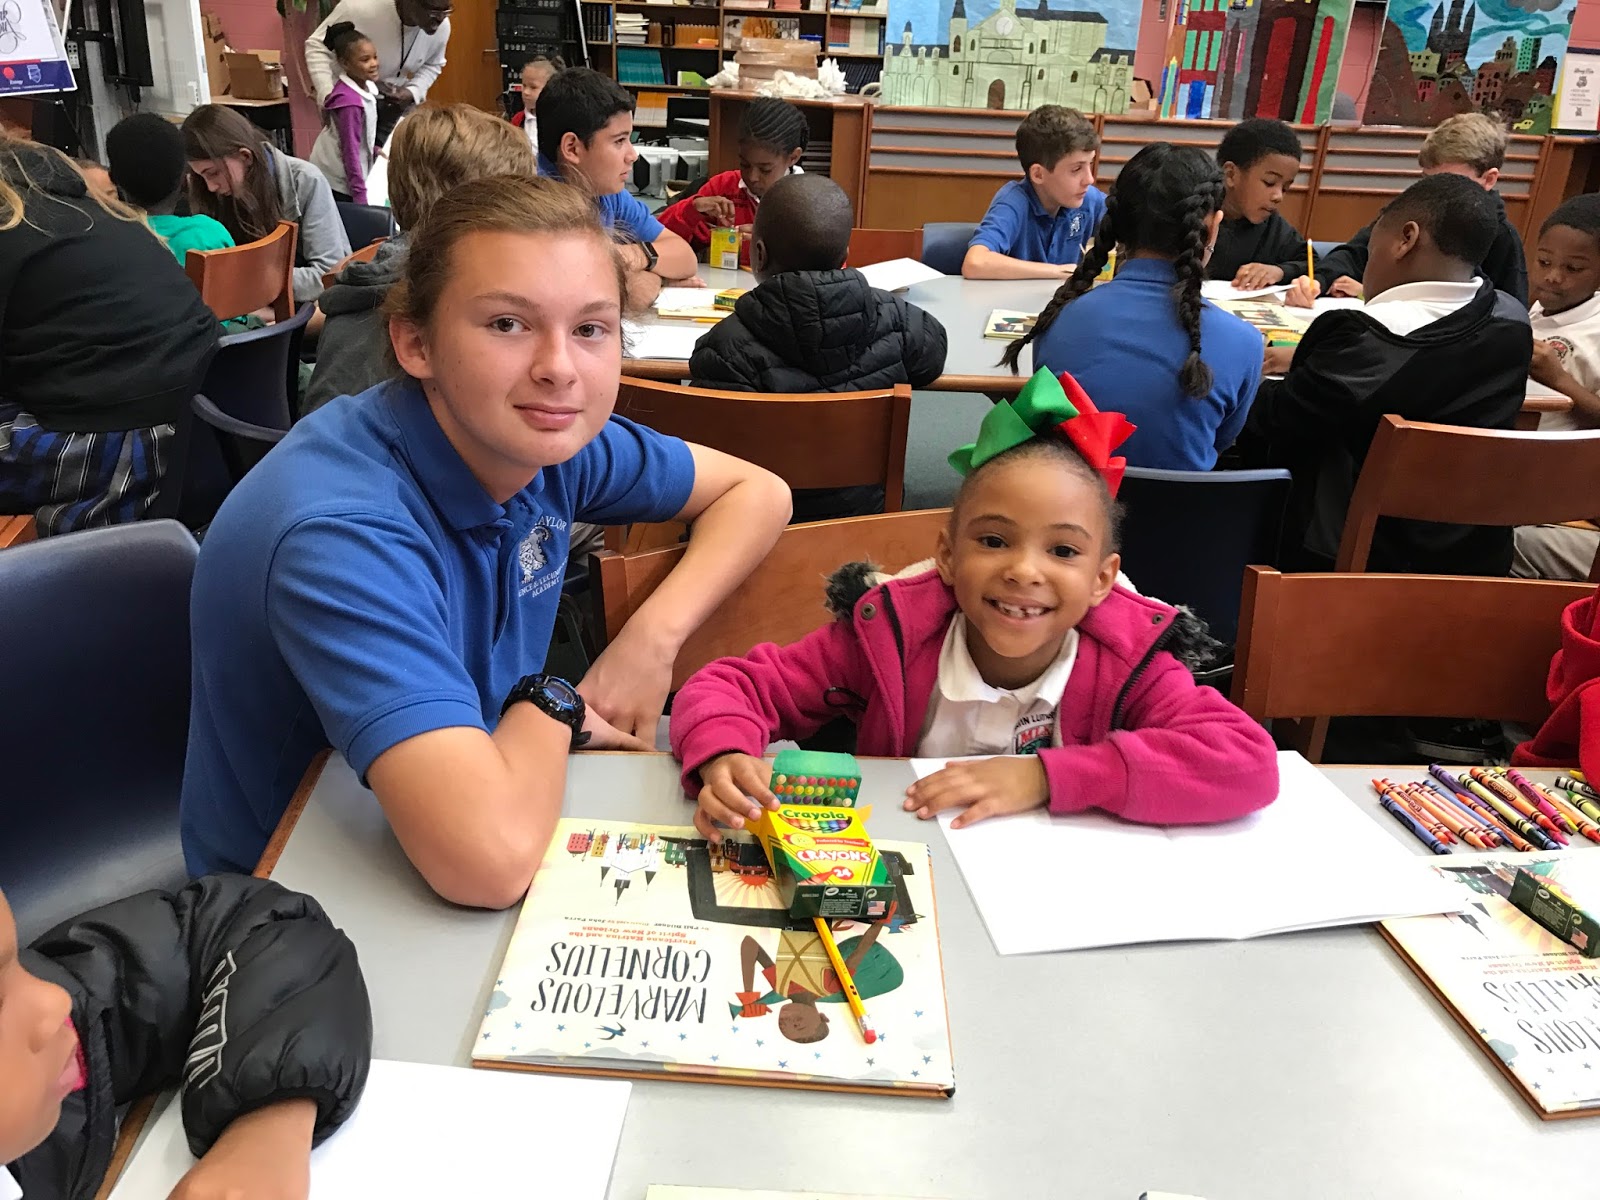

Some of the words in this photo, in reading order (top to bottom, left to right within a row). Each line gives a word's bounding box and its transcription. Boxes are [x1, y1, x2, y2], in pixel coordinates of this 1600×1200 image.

[535, 516, 567, 531] AYLOR
[531, 576, 560, 598] ACADEMY
[782, 809, 847, 820] Crayola
[796, 849, 872, 863] CRAYONS
[833, 867, 851, 878] 24
[568, 930, 585, 938] the
[581, 925, 620, 934] Orleans
[585, 931, 603, 939] and
[621, 928, 646, 936] New
[658, 930, 688, 938] Spirit
[605, 933, 645, 942] Katrina
[646, 936, 697, 946] Hurricane
[545, 941, 712, 984] CORNELIUS
[530, 977, 707, 1024] MARVELOUS
[1517, 1017, 1600, 1055] LOUS
